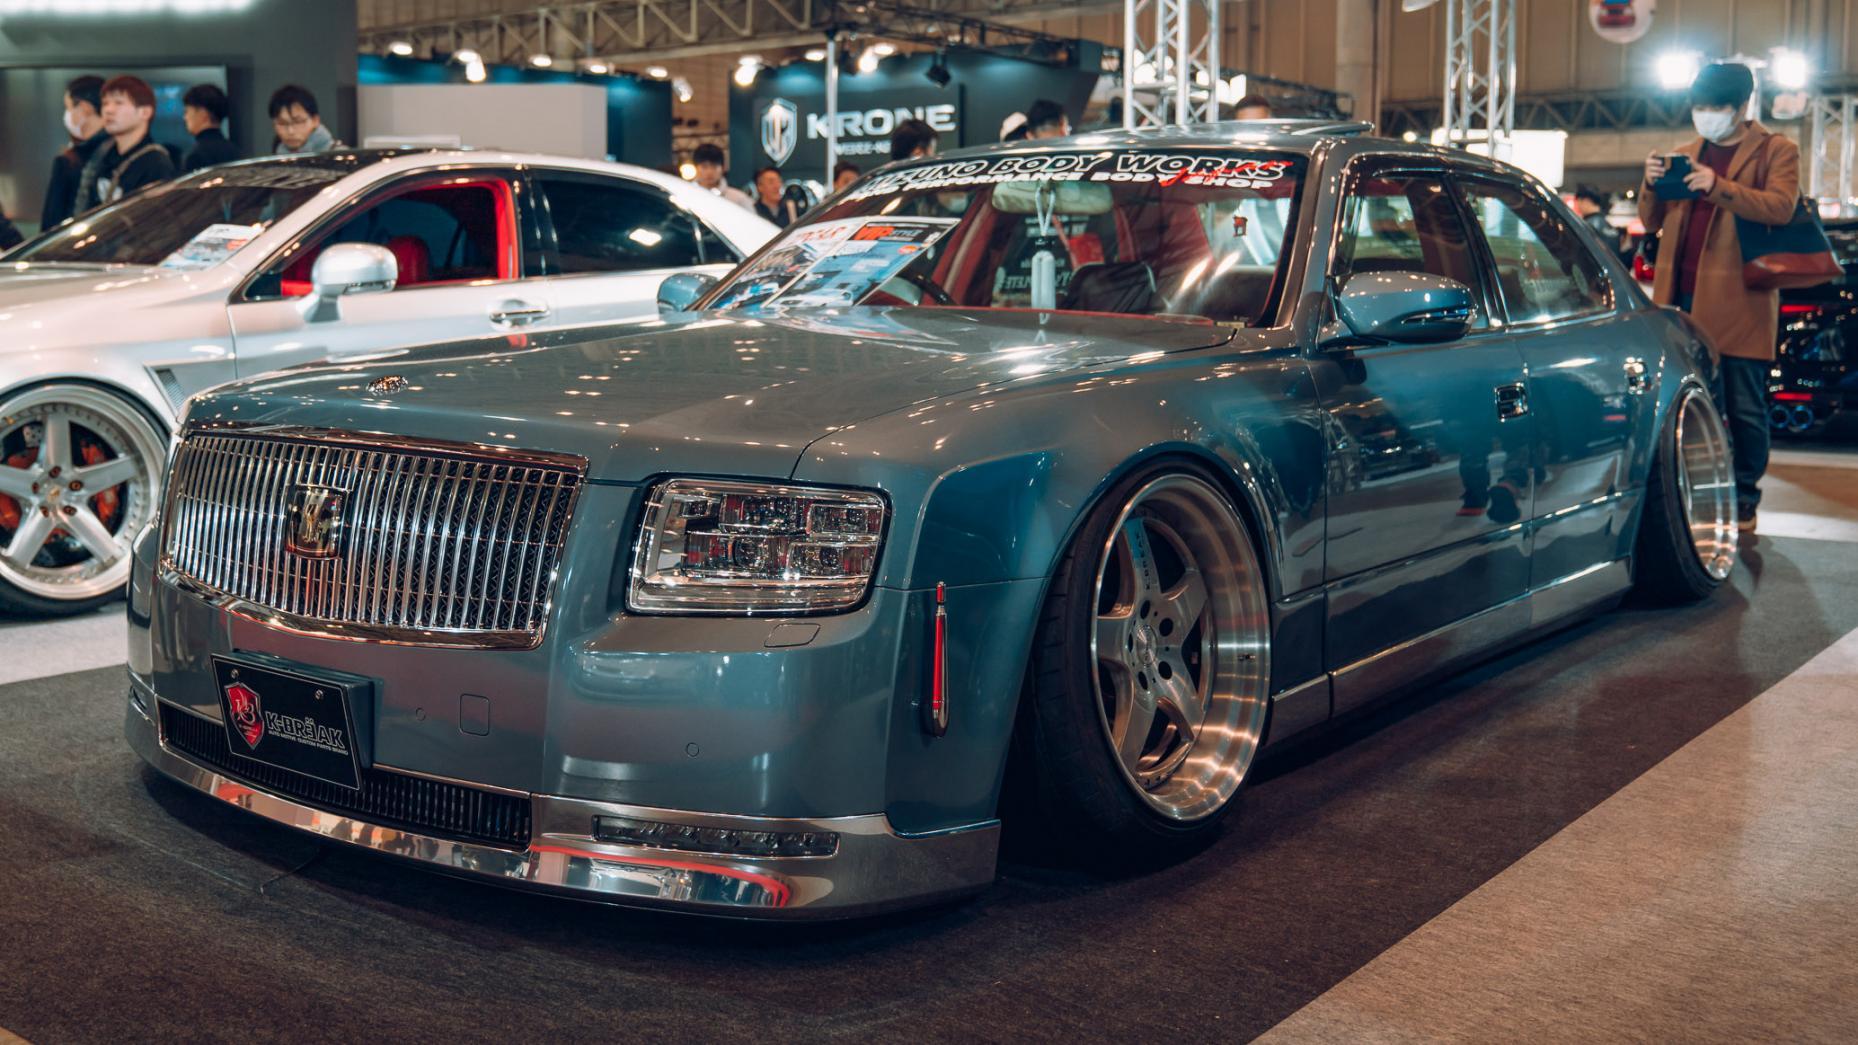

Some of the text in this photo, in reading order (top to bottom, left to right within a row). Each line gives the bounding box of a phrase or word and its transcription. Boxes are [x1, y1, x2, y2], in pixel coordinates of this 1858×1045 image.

[807, 104, 956, 139] KRONE
[988, 152, 1113, 174] BODY
[1117, 155, 1287, 181] WORKS
[902, 172, 1084, 191] PERFORMANCE
[1090, 172, 1178, 185] BODY
[1183, 175, 1273, 189] SHOP
